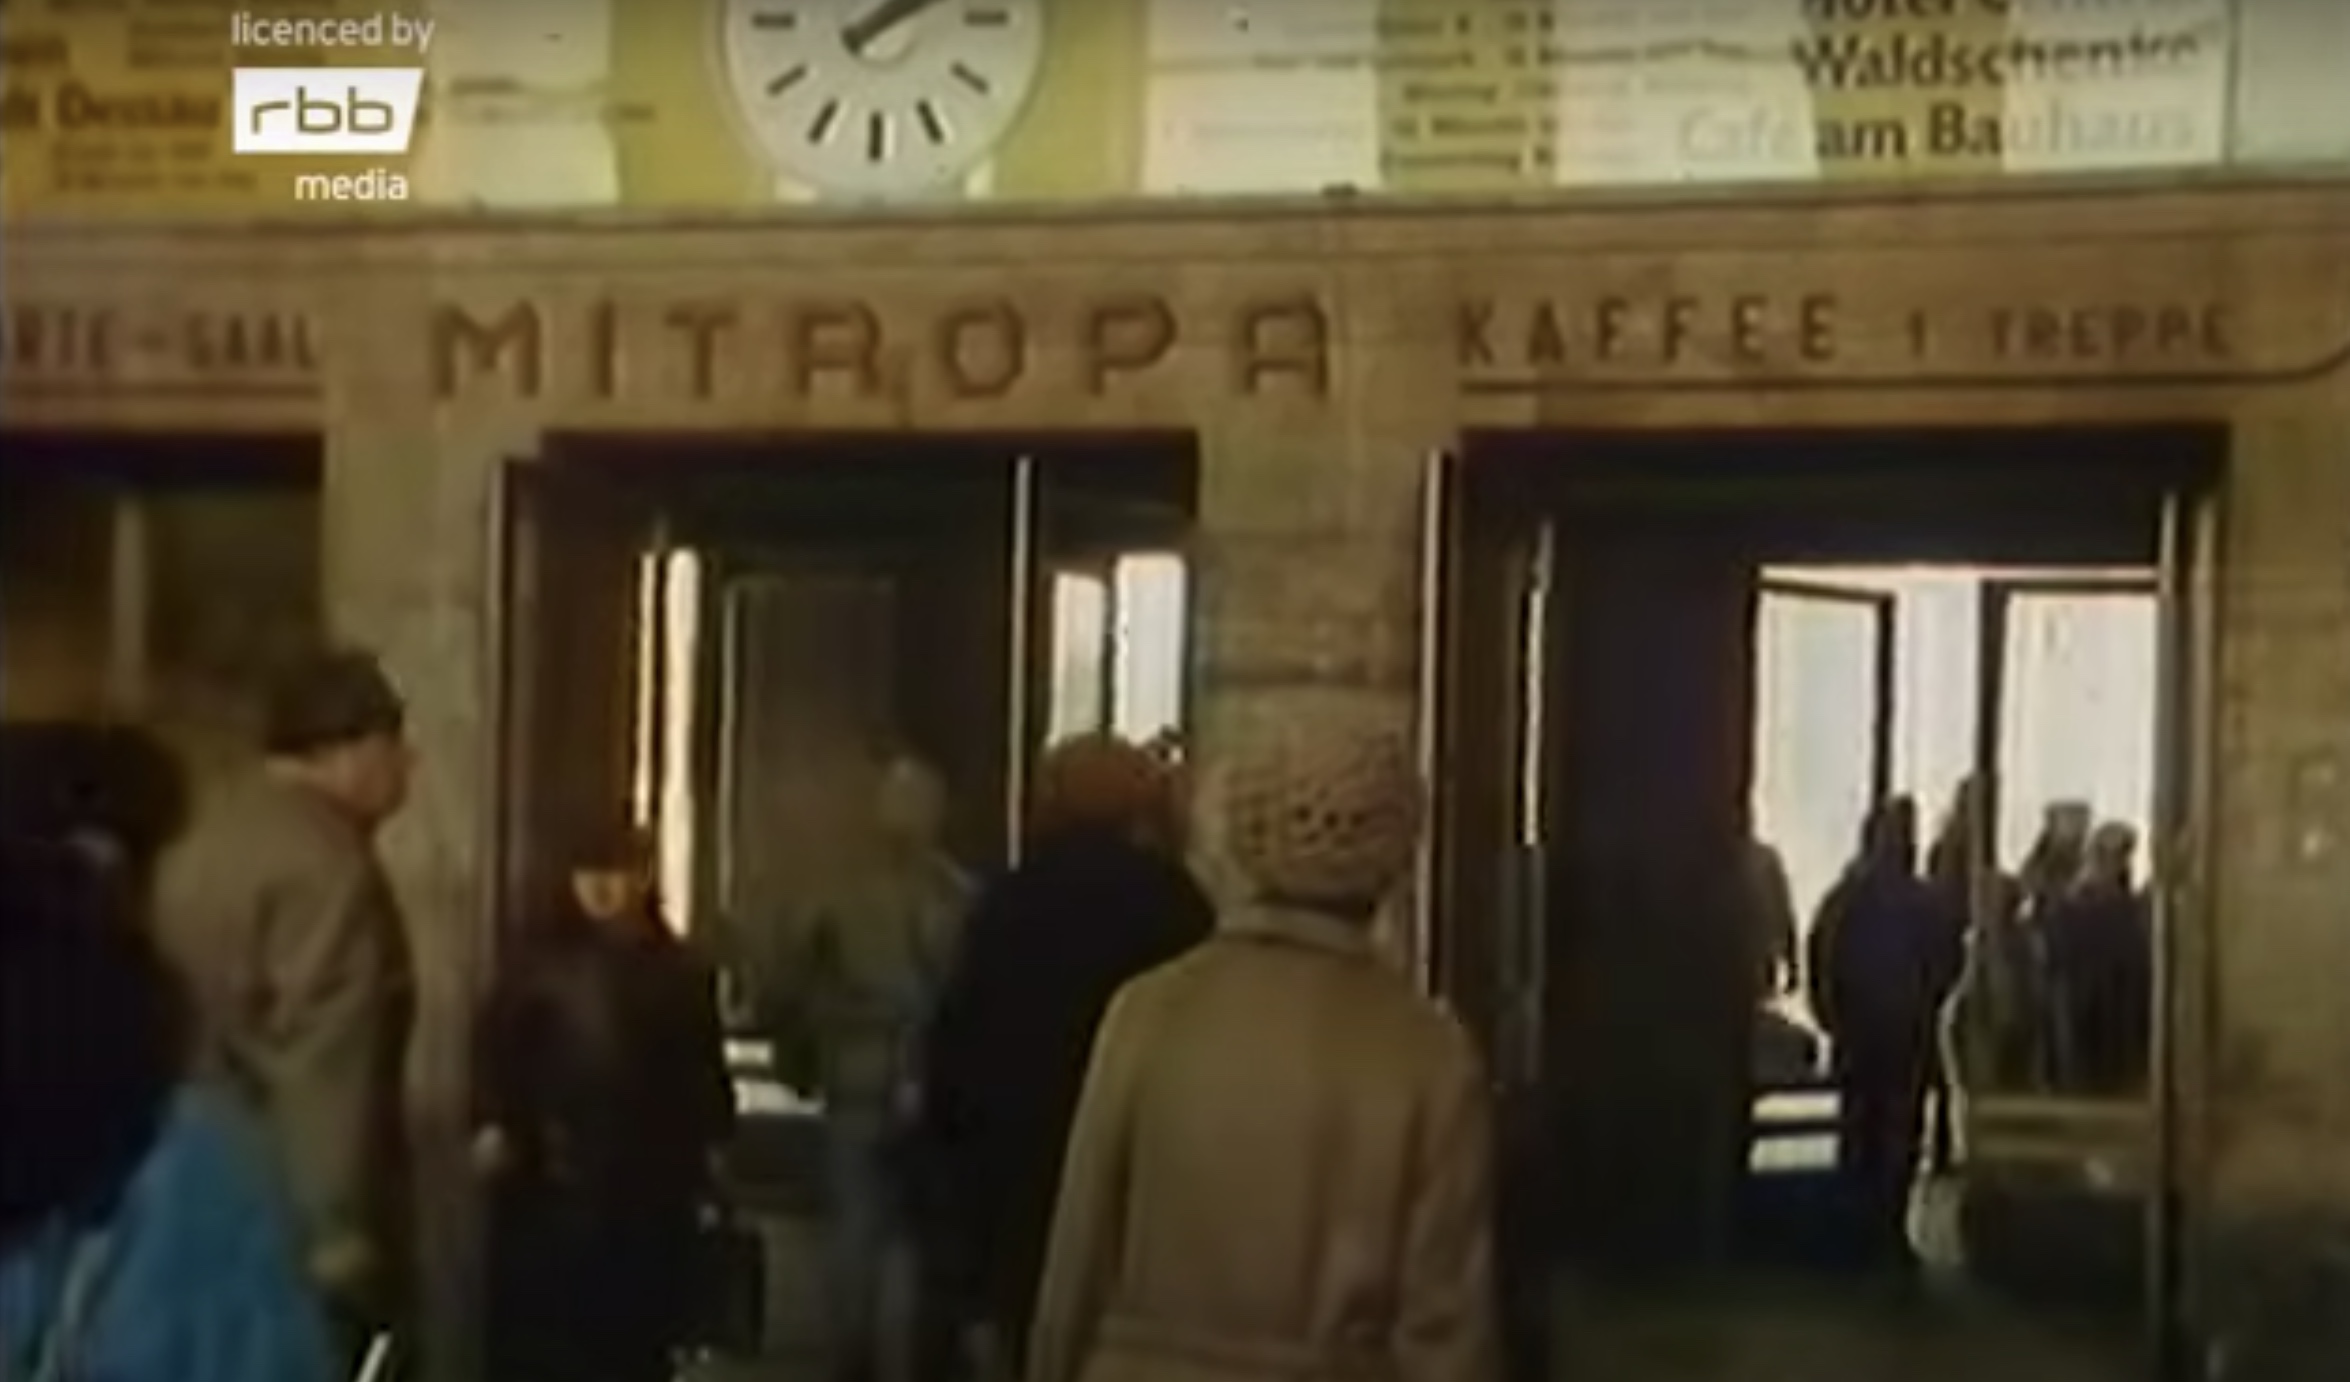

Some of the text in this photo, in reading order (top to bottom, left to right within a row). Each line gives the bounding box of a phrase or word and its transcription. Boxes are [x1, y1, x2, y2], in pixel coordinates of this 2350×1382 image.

[1814, 114, 1908, 158] am
[430, 296, 1330, 401] MITROPA
[1458, 295, 1837, 366] KAFFEE
[1990, 303, 2232, 357] TREPPE
